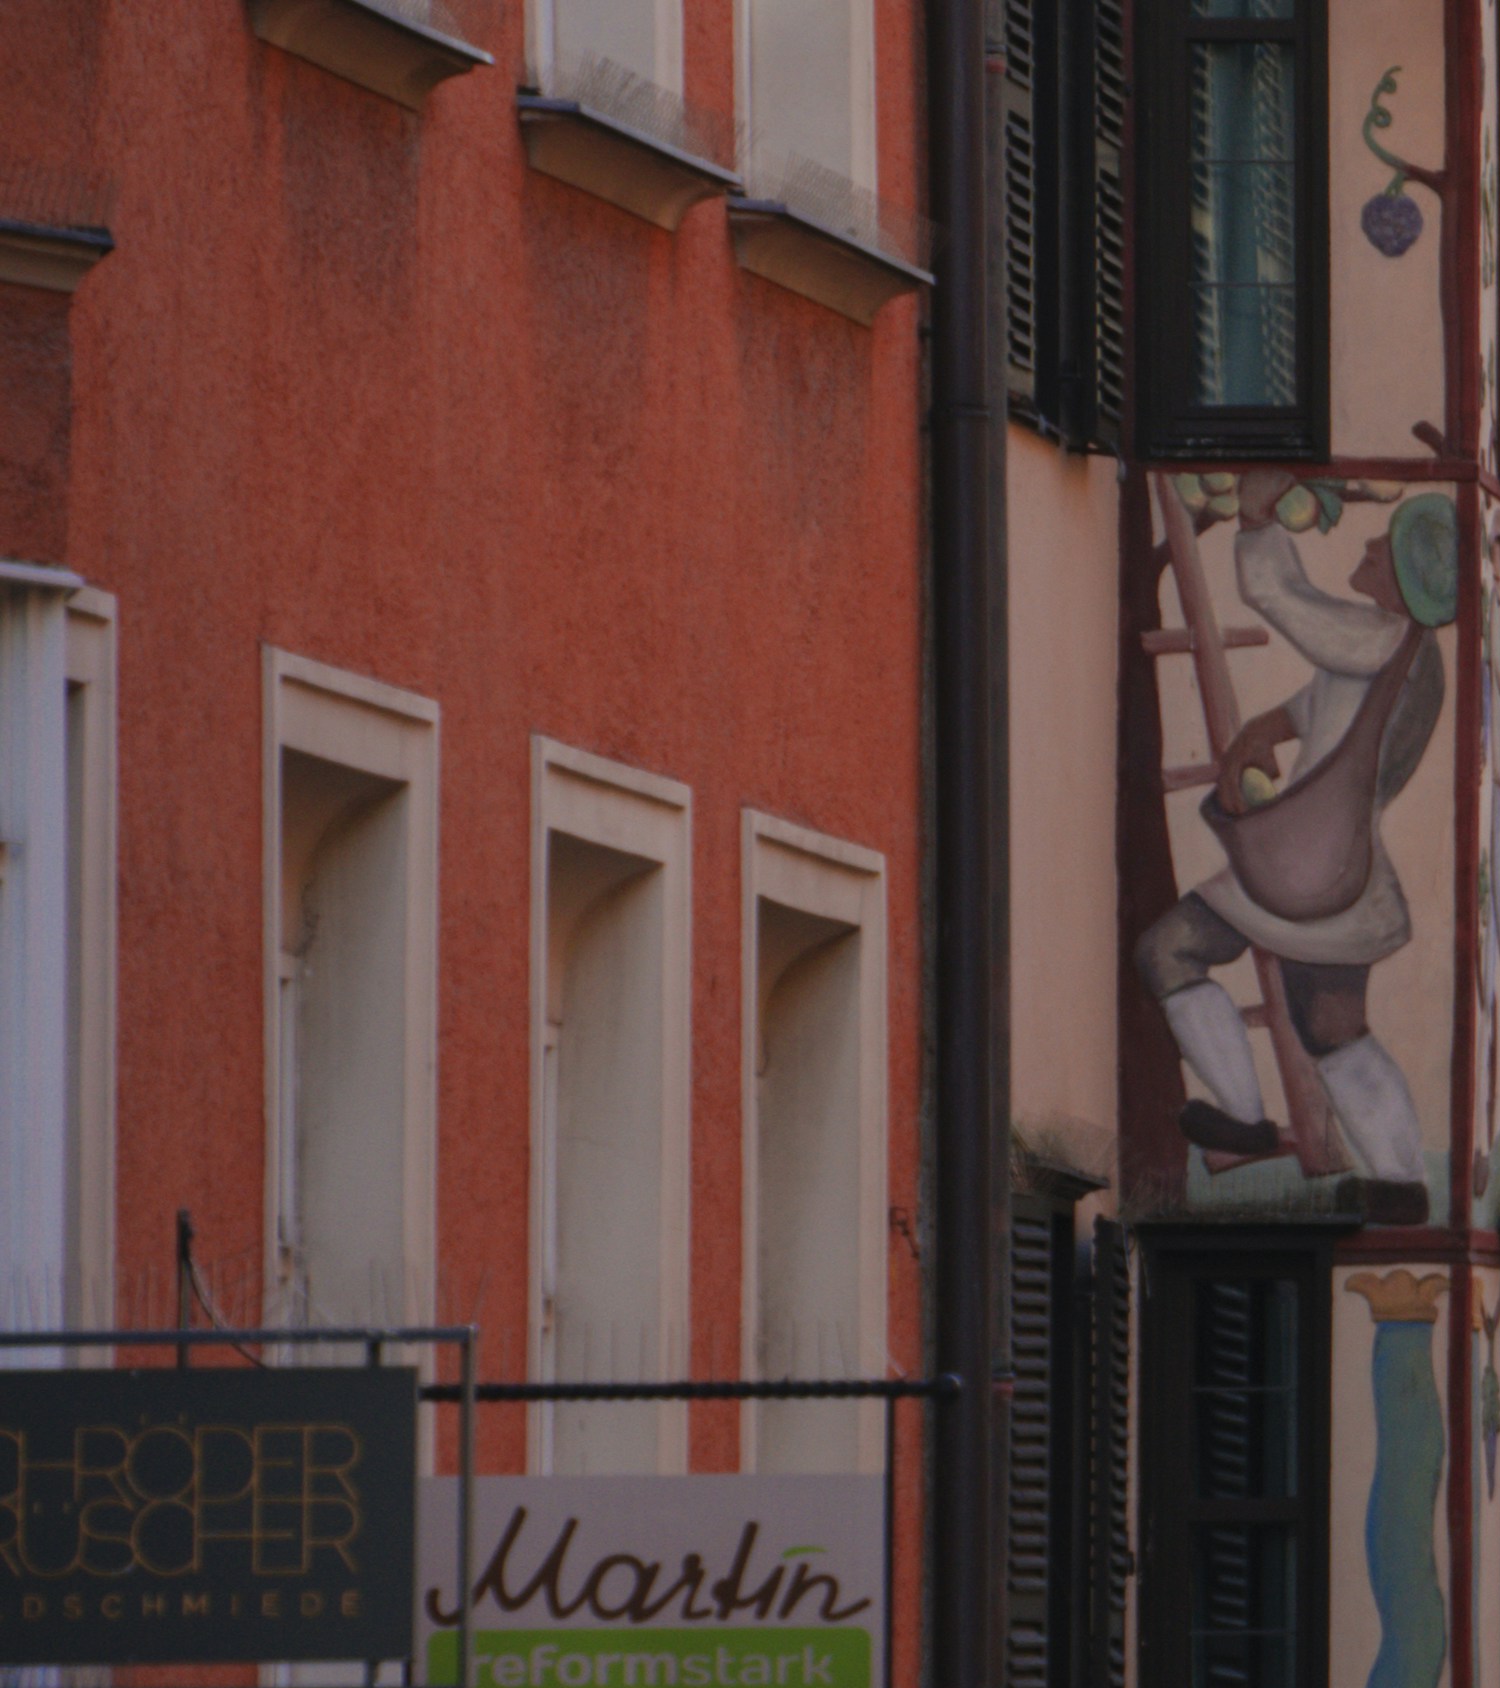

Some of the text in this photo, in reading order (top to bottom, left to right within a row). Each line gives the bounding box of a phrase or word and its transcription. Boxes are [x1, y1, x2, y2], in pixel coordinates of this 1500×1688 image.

[427, 1506, 872, 1626] Martin
[0, 1589, 363, 1621] DSCHMIEDE
[471, 1644, 835, 1688] reformstark
